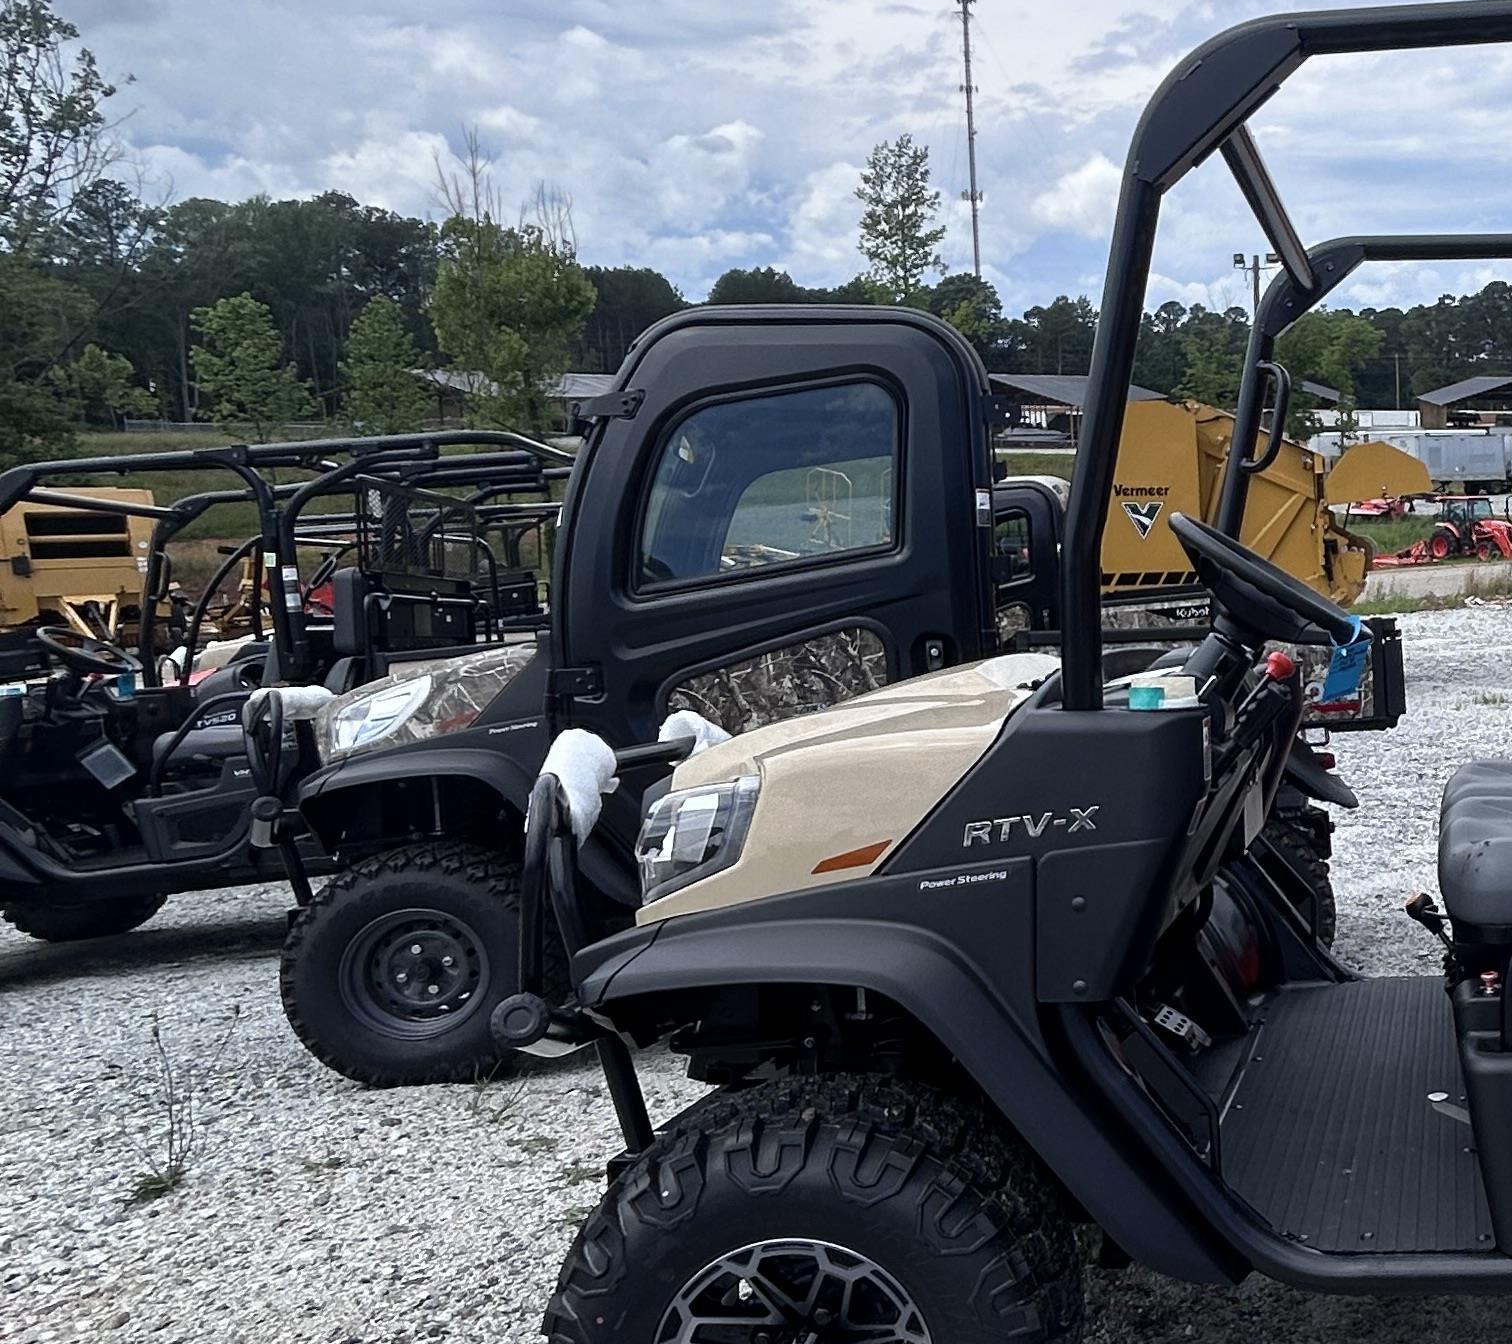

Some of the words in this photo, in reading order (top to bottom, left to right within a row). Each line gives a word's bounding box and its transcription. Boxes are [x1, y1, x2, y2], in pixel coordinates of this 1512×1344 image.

[1113, 484, 1170, 497] Vermeer
[1176, 606, 1210, 618] Kubot
[963, 806, 1100, 847] RTV-X
[919, 878, 957, 890] Power
[957, 870, 1008, 886] Steering
